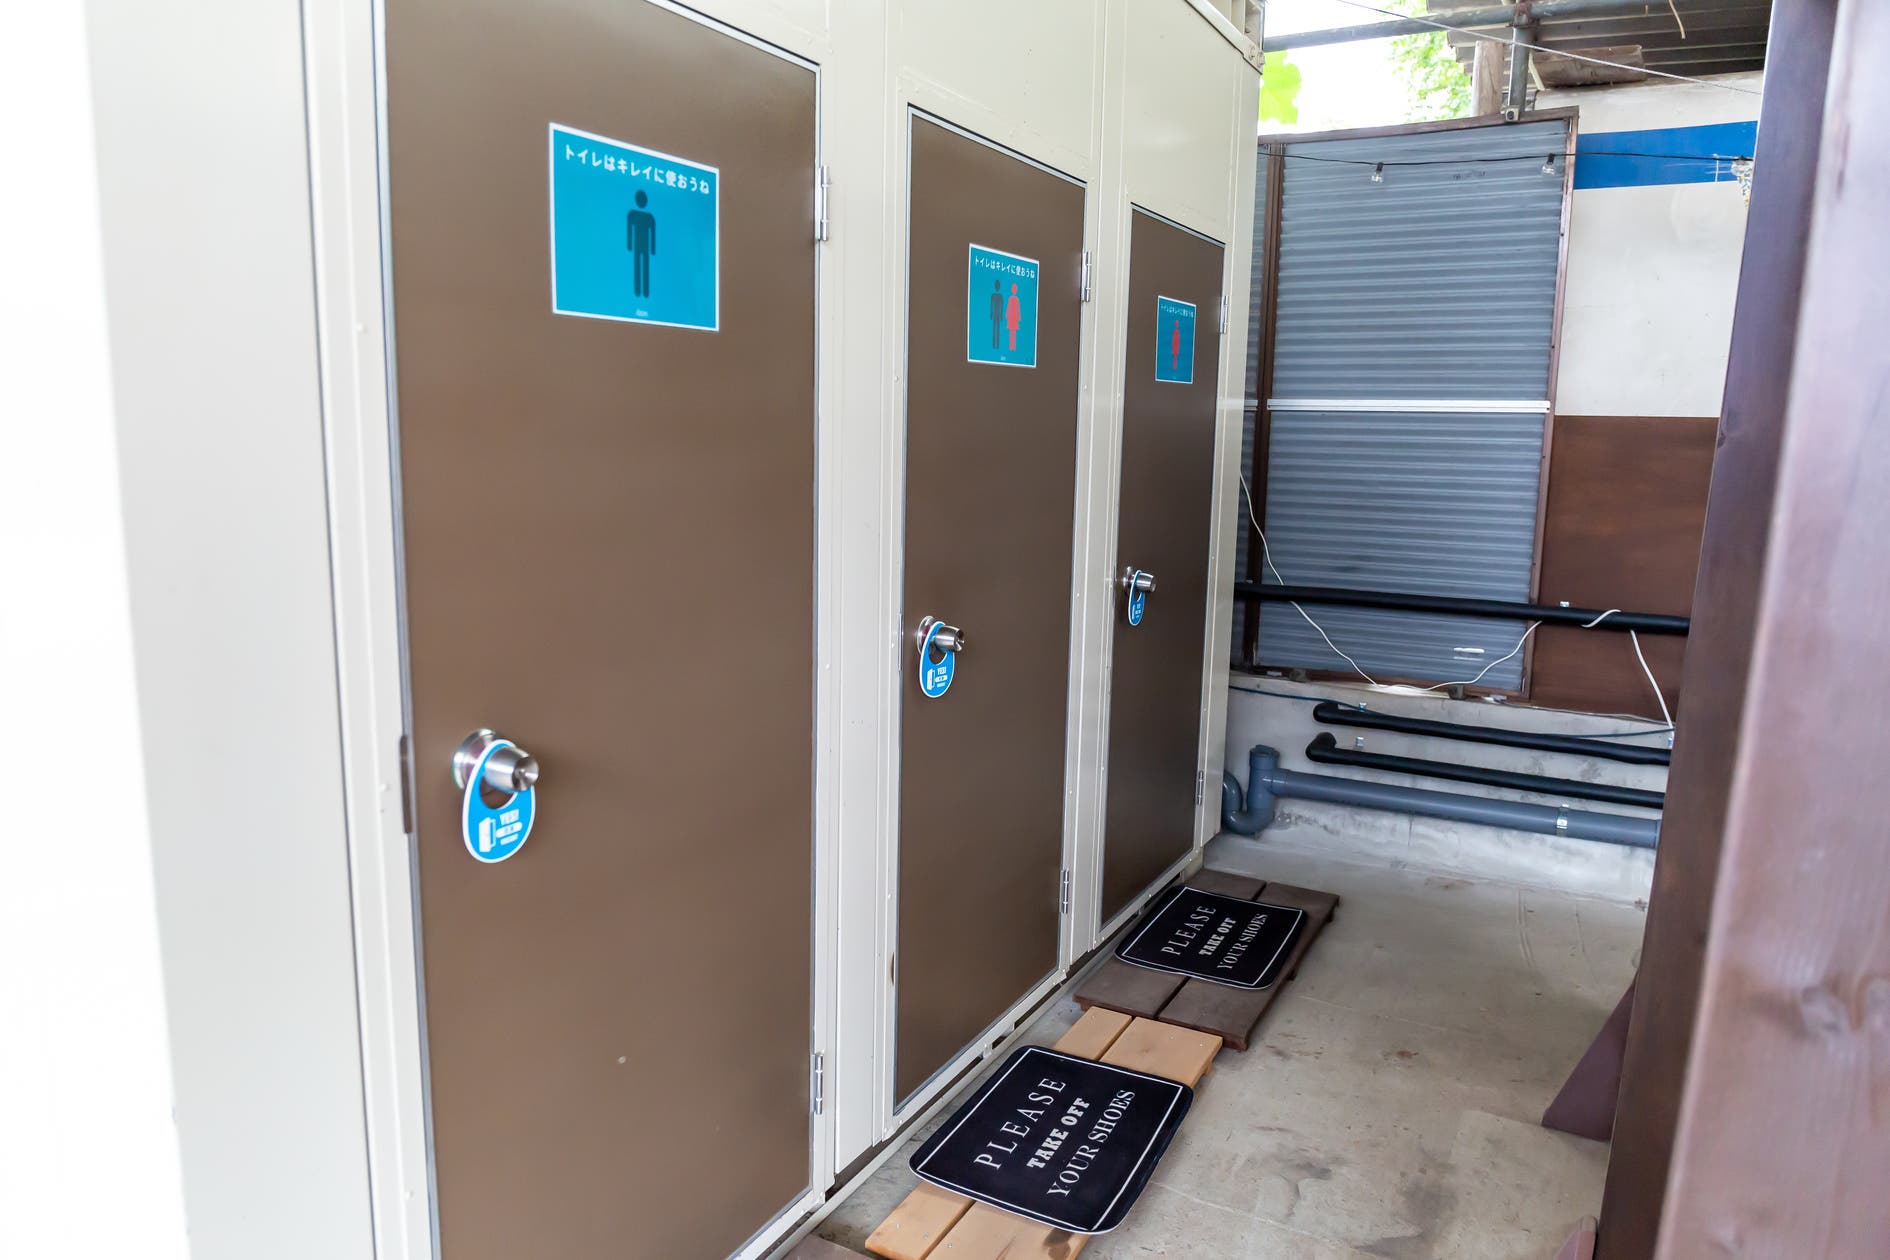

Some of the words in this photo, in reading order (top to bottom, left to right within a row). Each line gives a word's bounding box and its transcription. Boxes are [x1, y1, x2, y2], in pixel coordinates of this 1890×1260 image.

[565, 144, 710, 195] トイレはキレイに使おうね
[1161, 905, 1217, 955] PLEASE
[1198, 934, 1225, 956] TAKE
[1217, 917, 1237, 934] OFF
[1216, 942, 1249, 969] YOUR
[1238, 913, 1268, 942] SHOES
[973, 1078, 1067, 1170] PLEASE
[1026, 1128, 1070, 1169] TAKE
[1061, 1097, 1091, 1126] OFF
[1047, 1145, 1100, 1197] YOUR
[1087, 1089, 1136, 1143] SHOES
